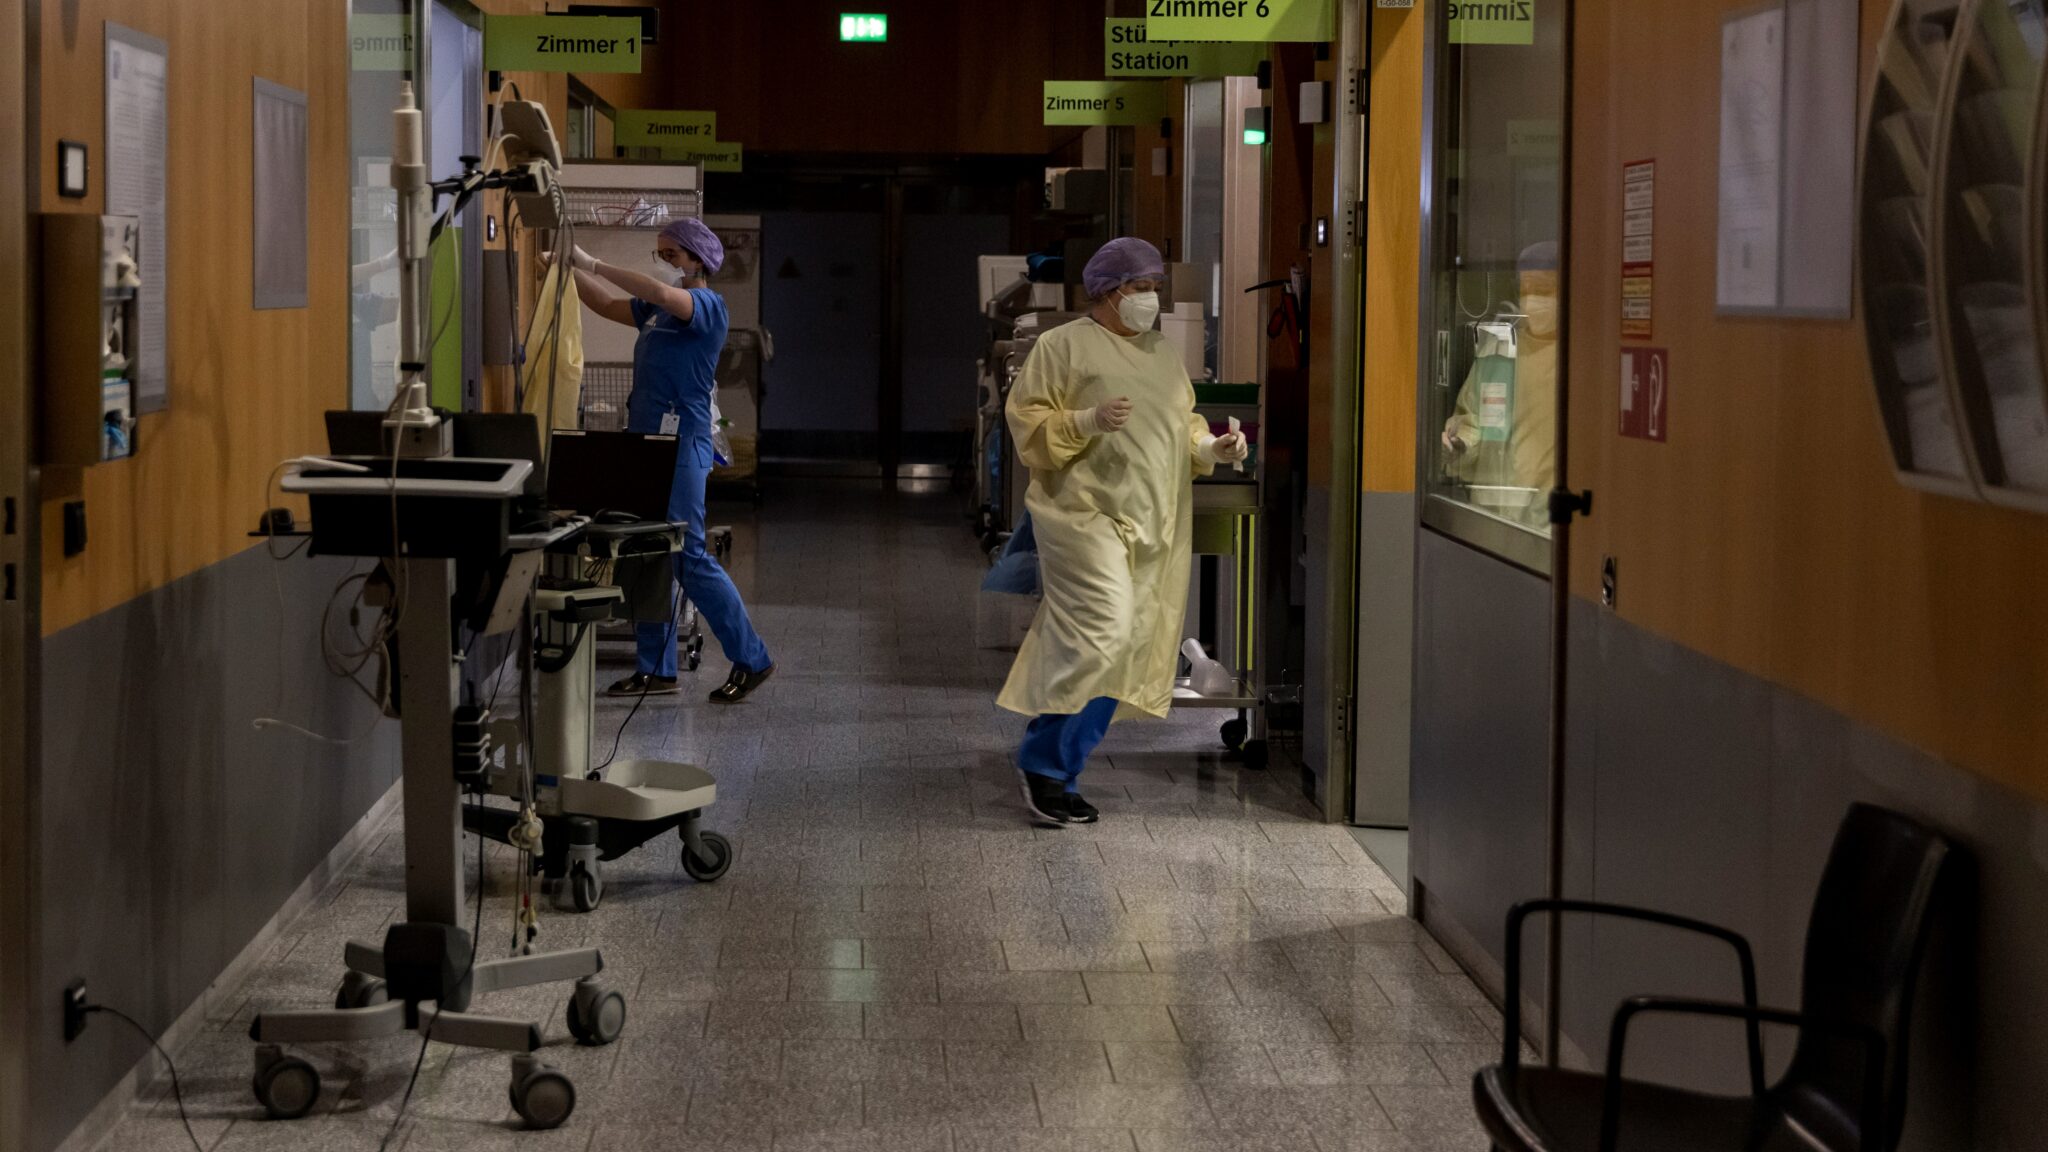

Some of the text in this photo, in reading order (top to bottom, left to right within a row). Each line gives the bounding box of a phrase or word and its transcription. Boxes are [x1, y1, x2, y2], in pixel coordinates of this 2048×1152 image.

[1149, 0, 1270, 18] Zimmer 6
[536, 35, 636, 54] Zimmer 1
[1111, 51, 1189, 70] Station
[1046, 96, 1125, 111] Zimmer 5
[646, 122, 712, 136] Zimmer 2
[686, 151, 740, 163] Zimmer 3
